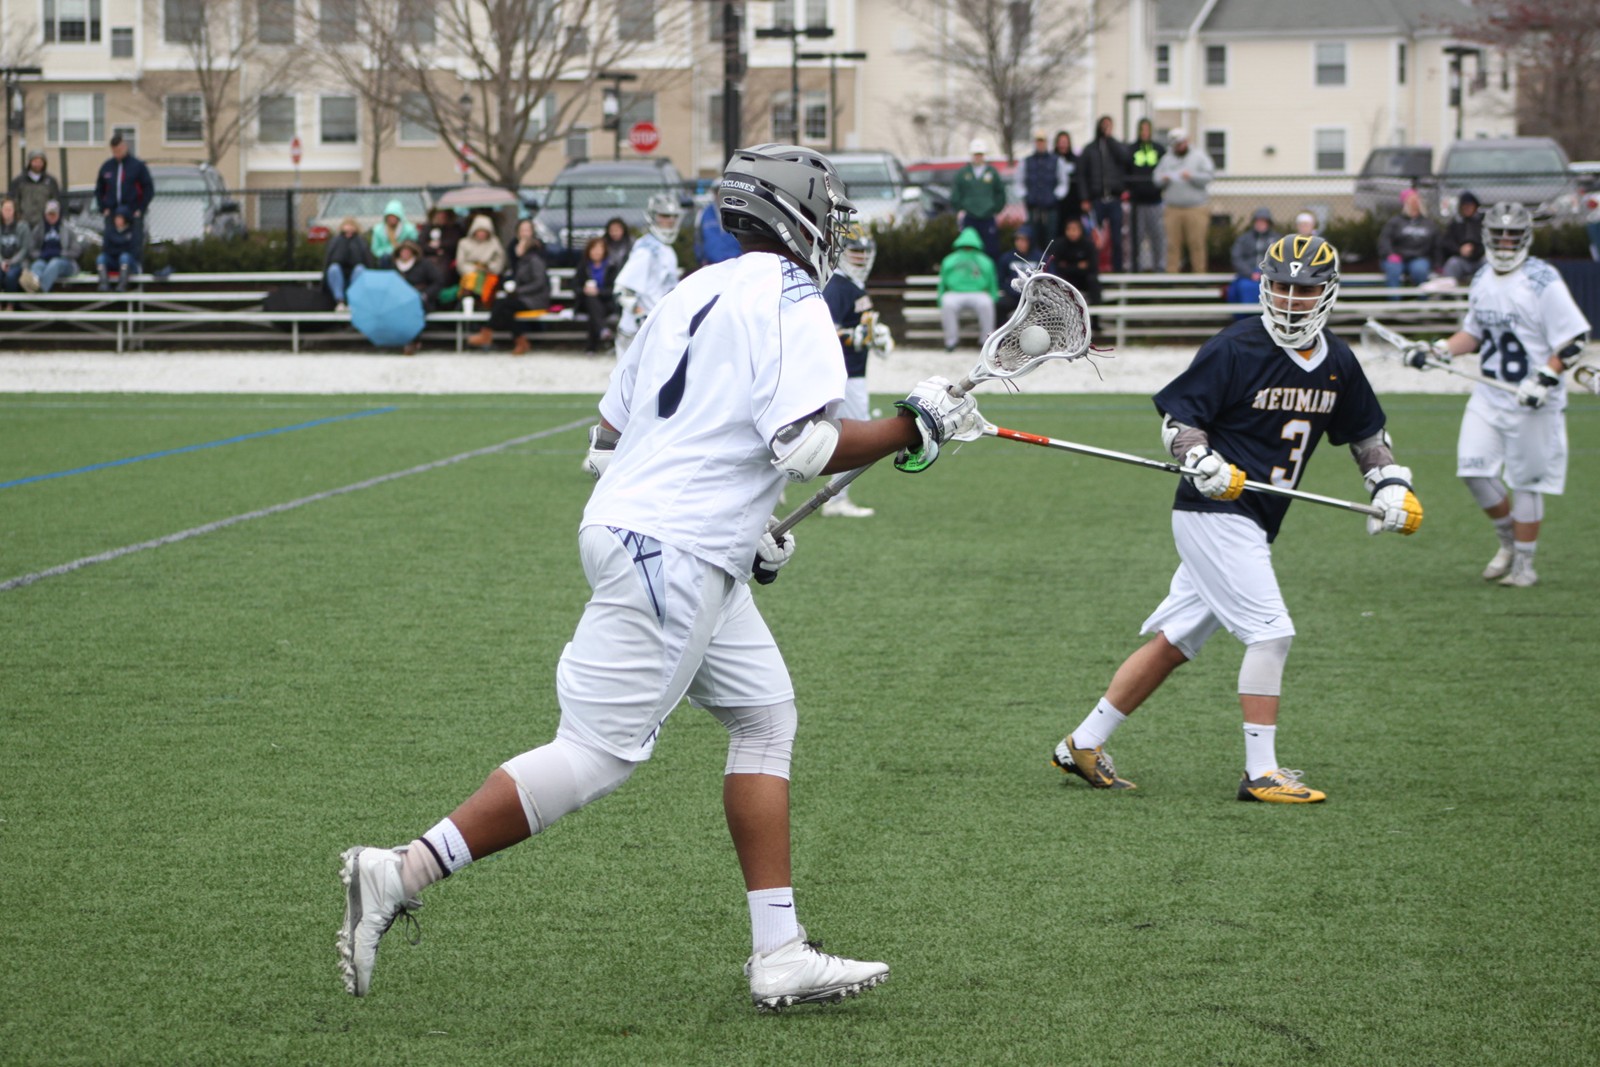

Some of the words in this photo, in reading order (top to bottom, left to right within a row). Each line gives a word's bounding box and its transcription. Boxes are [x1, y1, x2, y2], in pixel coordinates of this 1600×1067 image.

[720, 180, 756, 193] CYCLONES
[1480, 328, 1529, 384] 28
[1270, 419, 1312, 490] 3
